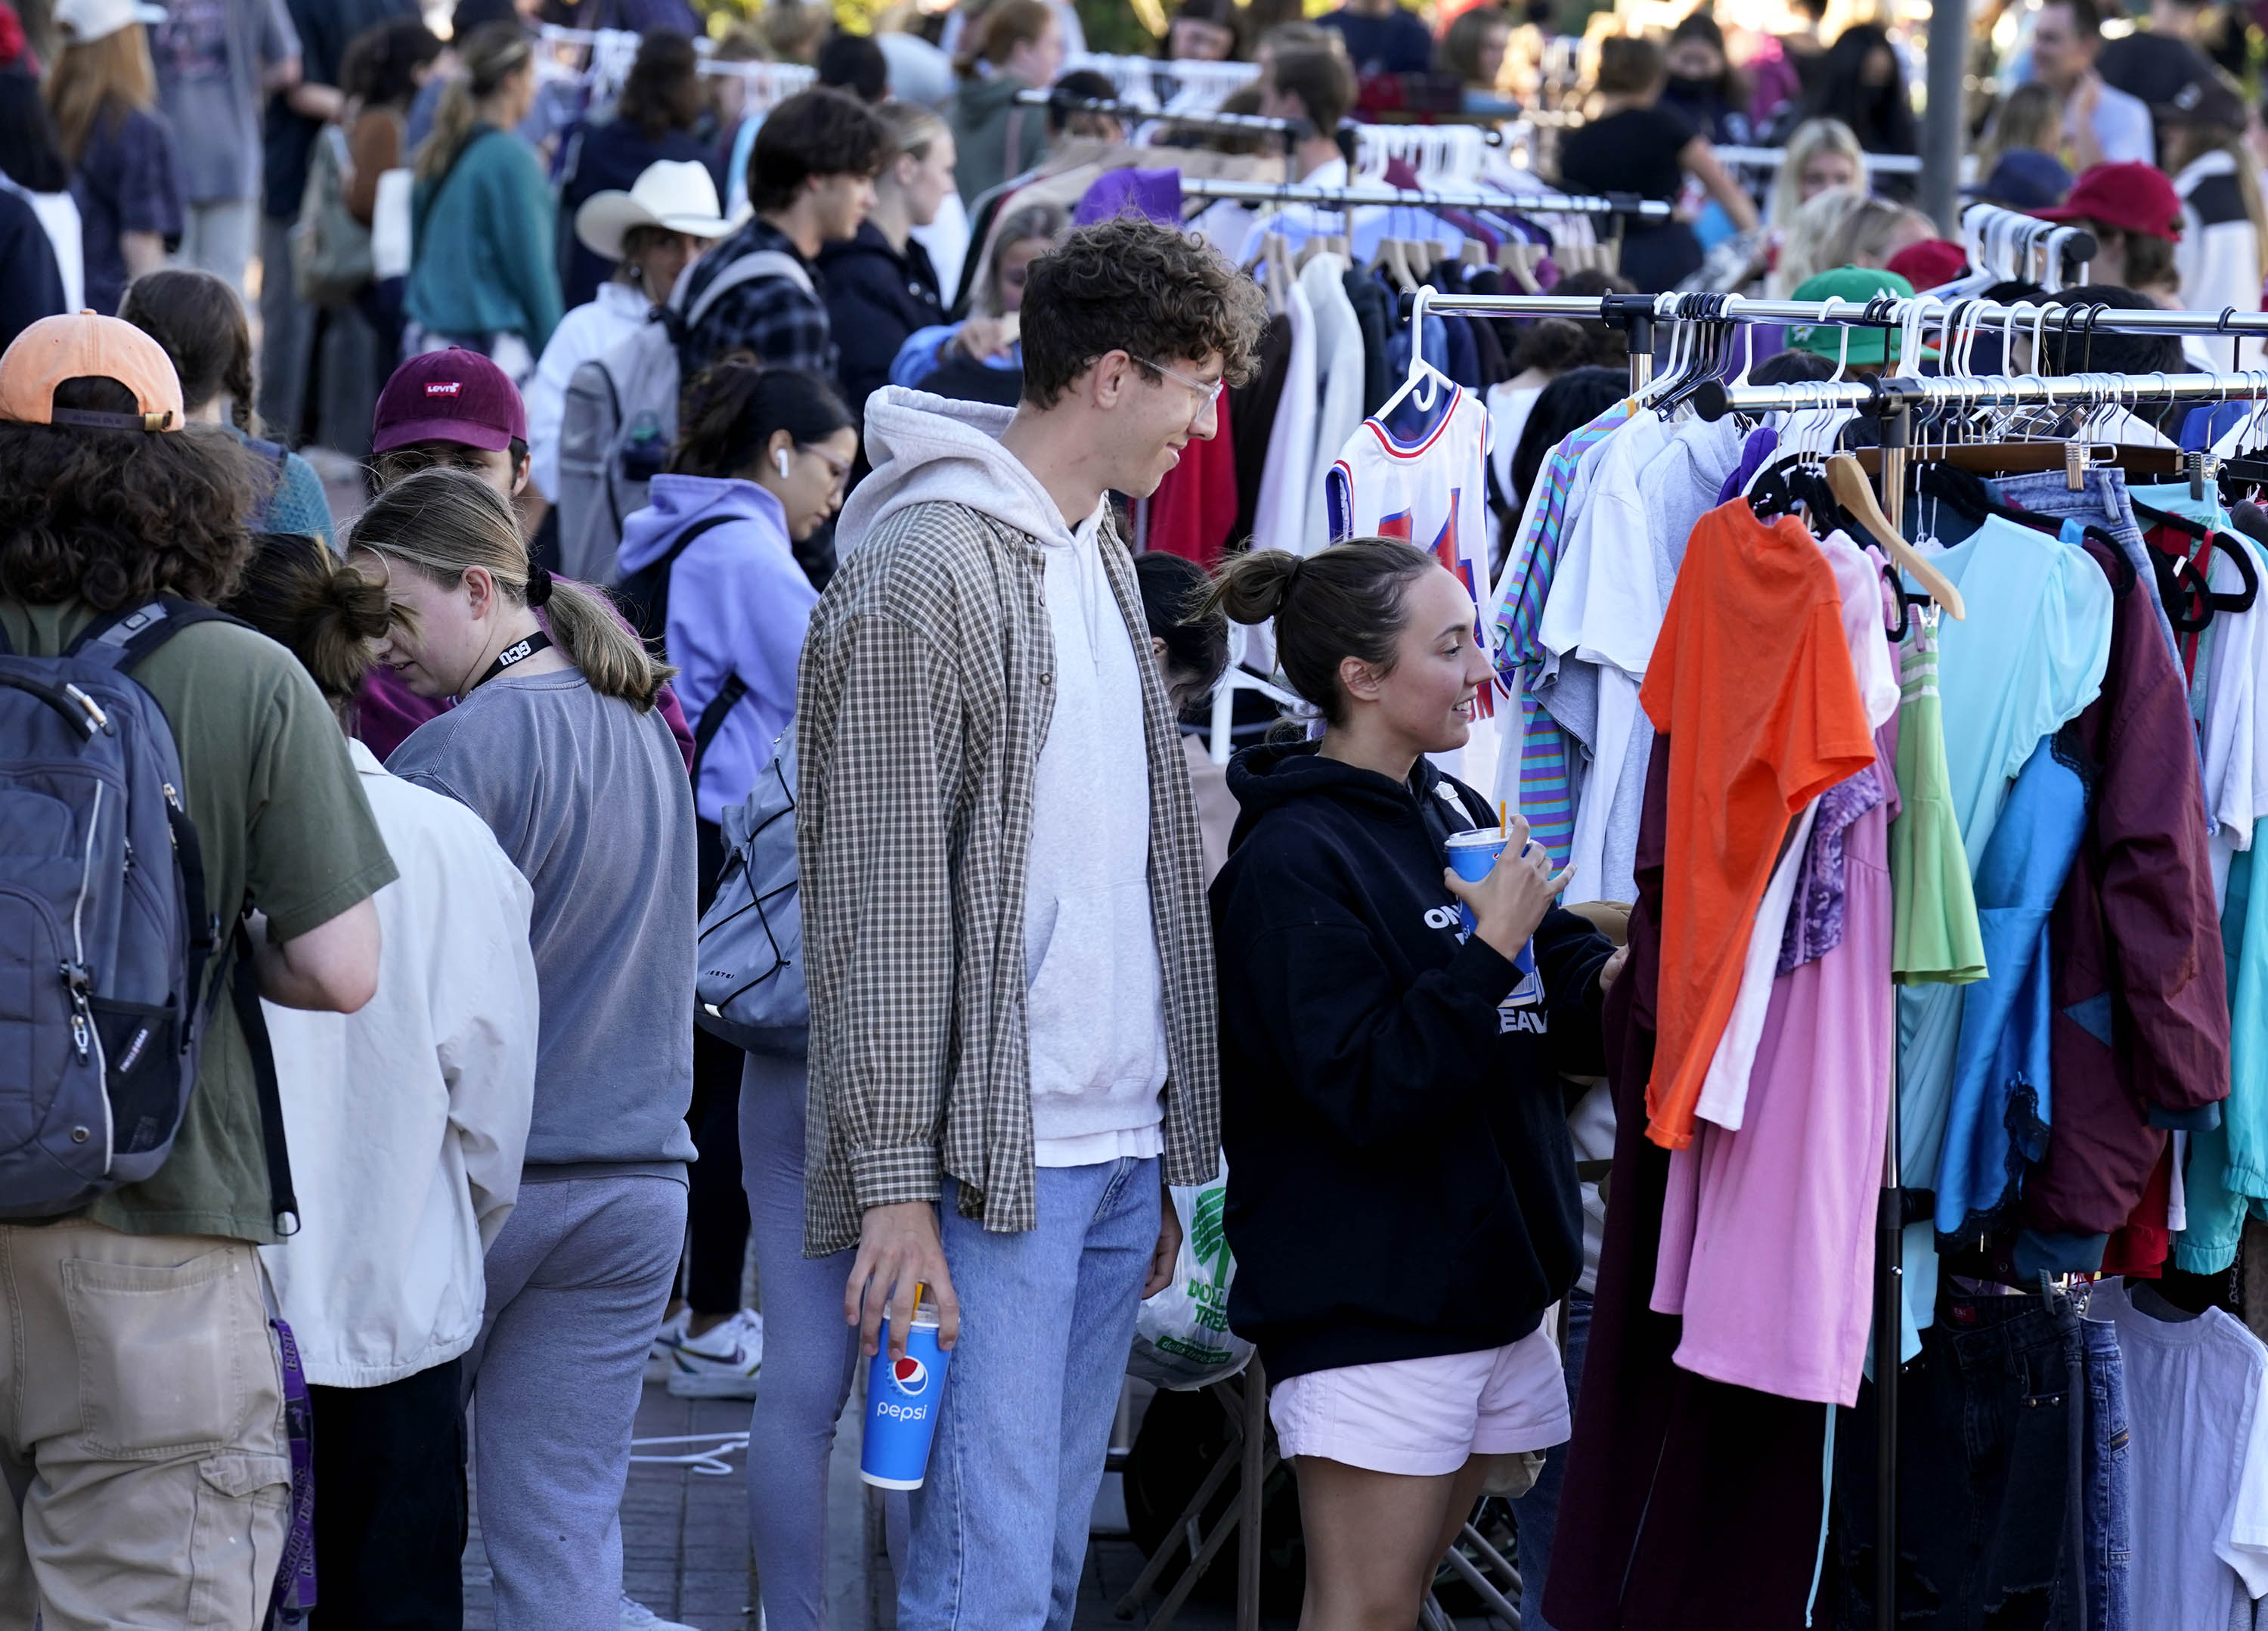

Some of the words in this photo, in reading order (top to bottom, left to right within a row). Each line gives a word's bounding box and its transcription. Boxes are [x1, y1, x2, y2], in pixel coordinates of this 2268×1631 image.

[499, 640, 531, 665] GCU
[1187, 1278, 1226, 1310] DOLL
[877, 1402, 928, 1422] pepsi
